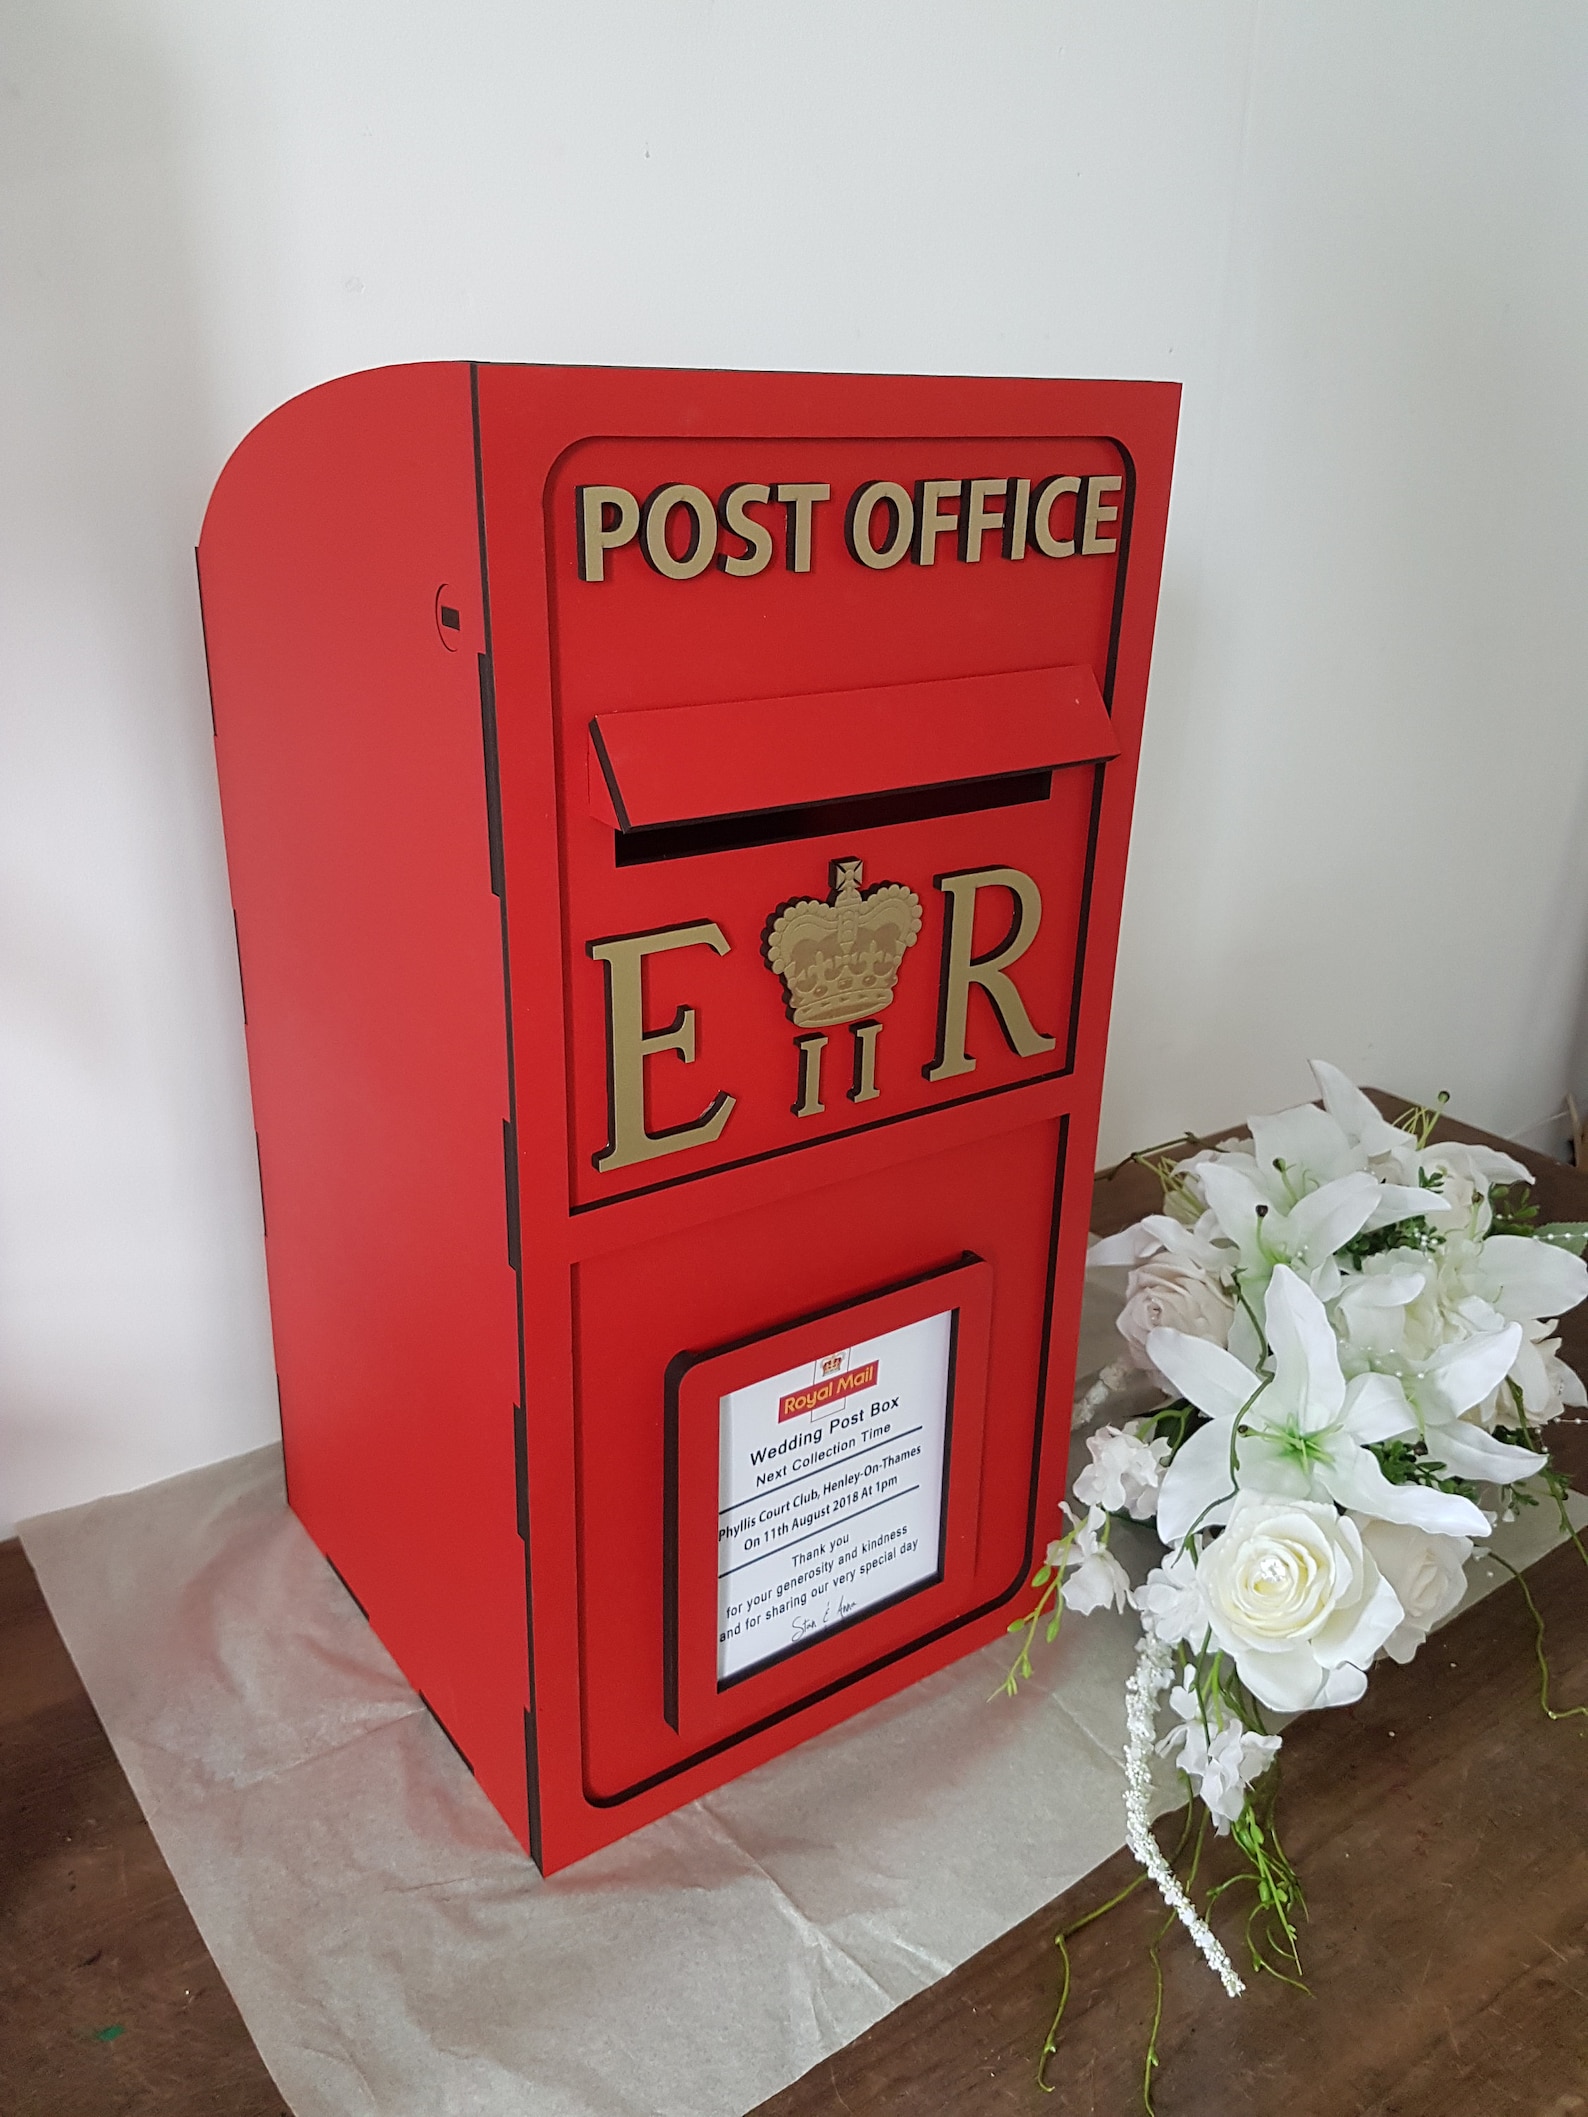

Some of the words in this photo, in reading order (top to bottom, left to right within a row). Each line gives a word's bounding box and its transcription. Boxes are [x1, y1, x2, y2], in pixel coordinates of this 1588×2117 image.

[576, 482, 830, 582] POST
[846, 475, 1122, 570] OFFICE
[585, 918, 736, 1173] E
[922, 864, 1056, 1081] R
[791, 1020, 883, 1117] II
[750, 1428, 822, 1466] Wedding
[829, 1409, 864, 1434] Post
[870, 1397, 900, 1417] Box
[784, 1382, 833, 1414] Royal
[837, 1366, 873, 1394] Mail
[718, 1516, 756, 1542] Phyllis
[759, 1501, 790, 1521] Court
[793, 1489, 820, 1508] Club,
[823, 1444, 921, 1495] Henley-On-Thames
[756, 1467, 787, 1488] Next
[792, 1438, 856, 1471] Collection
[861, 1423, 891, 1442] Time
[744, 1537, 760, 1551] On
[764, 1524, 789, 1542] 11th
[791, 1506, 830, 1531] August
[833, 1491, 858, 1512] 2018
[861, 1485, 873, 1500] At
[876, 1475, 898, 1493] 1pm
[792, 1546, 826, 1567] Thank
[829, 1533, 849, 1553] you
[719, 1625, 741, 1642] and
[745, 1615, 761, 1629] for
[765, 1593, 807, 1620] sharing
[811, 1582, 829, 1598] our
[833, 1567, 856, 1587] very
[859, 1547, 896, 1575] special
[900, 1538, 919, 1555] day
[726, 1605, 743, 1619] for
[746, 1589, 772, 1612] your
[776, 1560, 834, 1598] generosity
[838, 1547, 858, 1565] and
[862, 1525, 907, 1554] kindness
